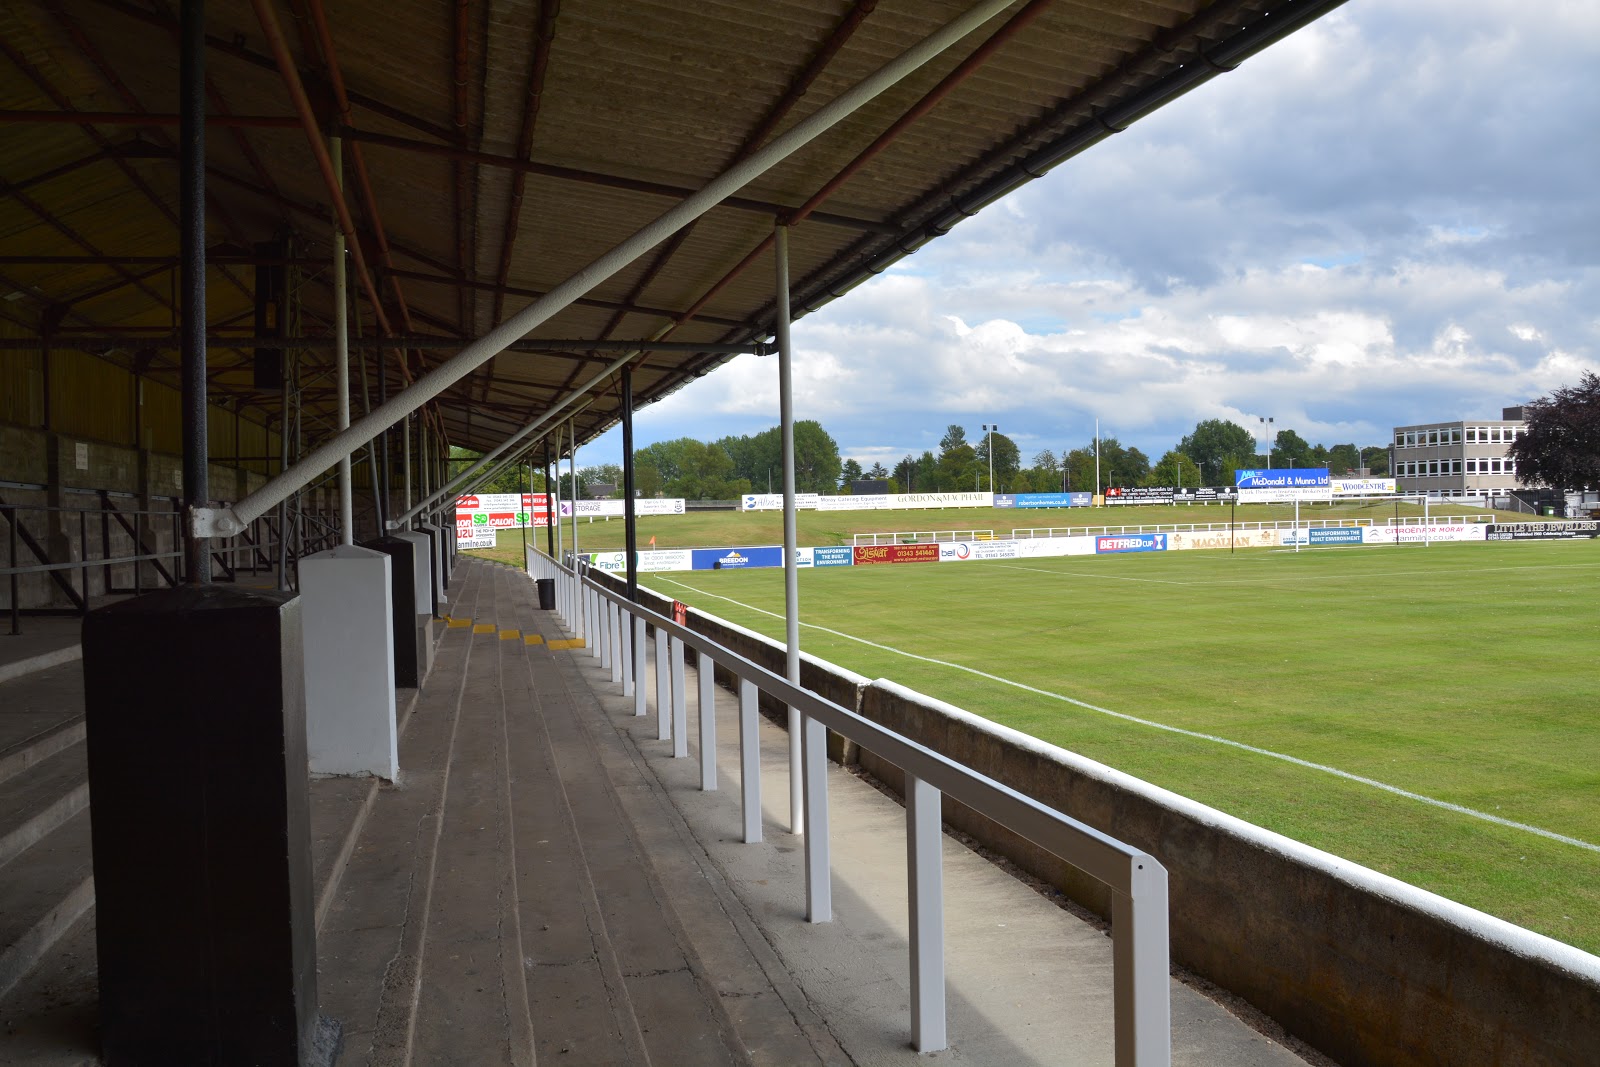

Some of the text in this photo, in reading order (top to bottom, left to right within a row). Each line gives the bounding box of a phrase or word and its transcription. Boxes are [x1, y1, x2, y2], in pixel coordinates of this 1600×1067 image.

[1251, 476, 1328, 486] McDonald & Munro Ltd
[1341, 482, 1387, 491] WOODCENTRE
[1105, 487, 1121, 497] A&H
[897, 493, 936, 502] GORDON
[457, 519, 471, 527] LOR
[490, 518, 513, 526] CALOR
[1494, 521, 1598, 532] LITTLE THE JEWELLERS
[1099, 538, 1142, 549] BETFRED
[1191, 537, 1250, 548] MACALLAN
[941, 549, 956, 557] bell
